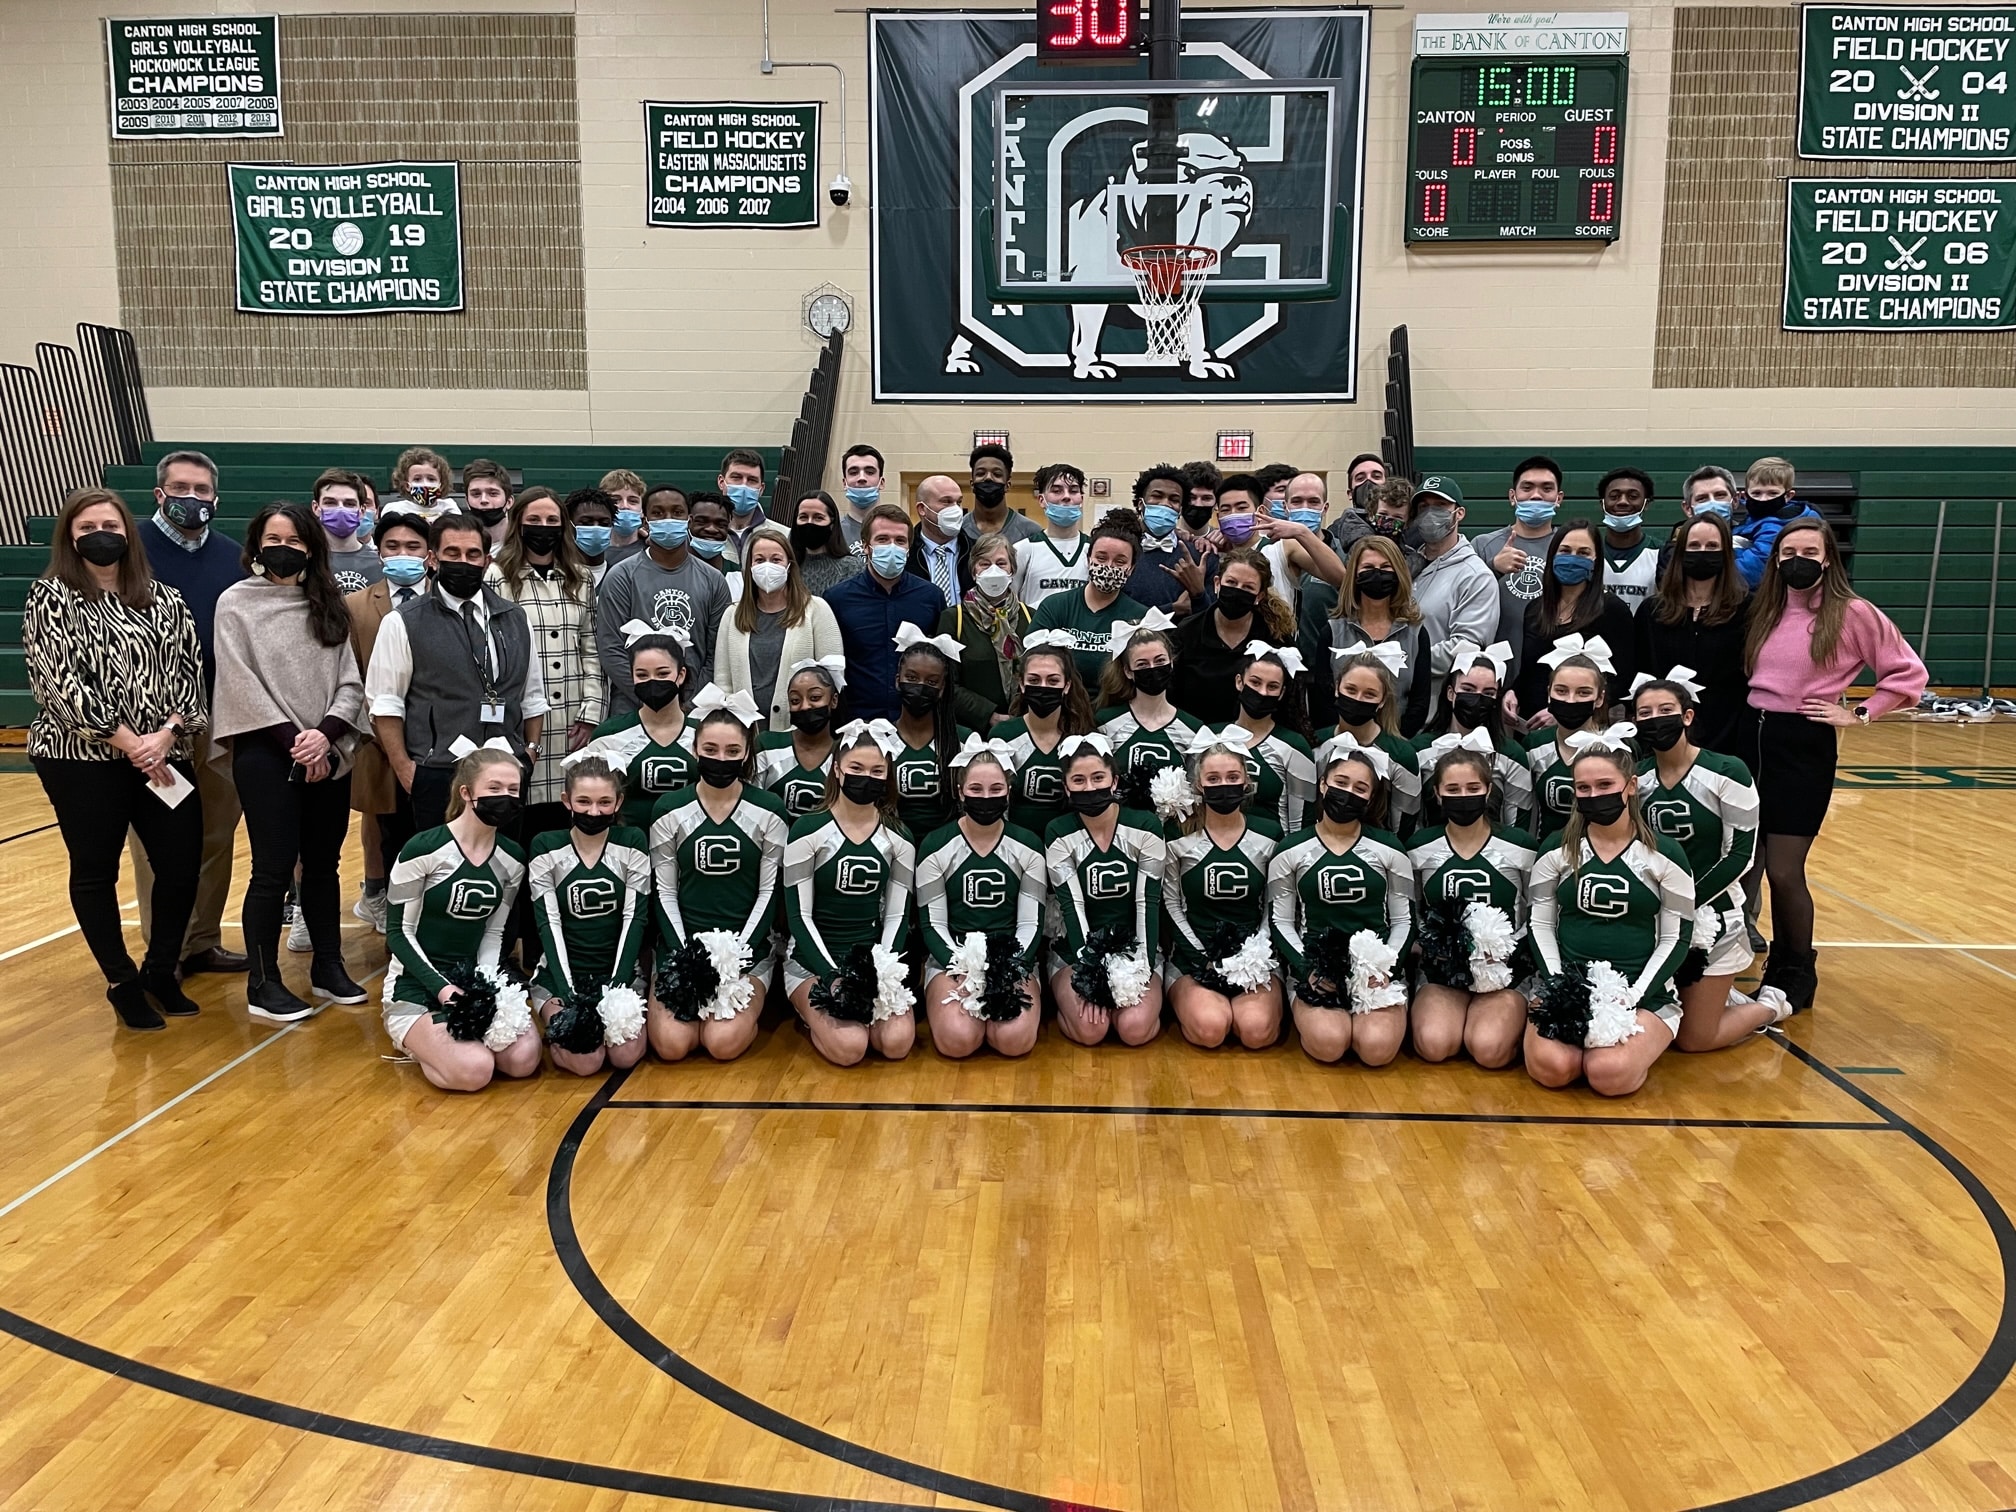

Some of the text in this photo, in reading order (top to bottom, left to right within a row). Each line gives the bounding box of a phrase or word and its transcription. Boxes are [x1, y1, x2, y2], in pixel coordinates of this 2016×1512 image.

[1488, 13, 1557, 28] We're with you!
[1832, 16, 2015, 32] CANTON HIGH SCHOOL
[124, 23, 261, 38] CANTON HIGH SCHOOL
[131, 39, 256, 56] GIRLS VOLLEYBALL
[1420, 32, 1622, 50] THE BANK OF CANTON
[1833, 37, 2010, 61] FIELD HOCKEY
[130, 58, 259, 74] HOCKOMOCK LEAGUE
[128, 76, 263, 94] CHAMPIONS
[1477, 67, 1575, 106] 15:00
[1829, 70, 2007, 94] 20 04
[121, 97, 274, 110] 2003 2004 2005 2007 2008
[1853, 103, 1980, 121] DIVISION II
[122, 113, 270, 128] 2009 2010 2011 2012 2013
[664, 114, 801, 127] CANTON HIGH SCHOOL
[1496, 112, 1536, 122] PERIOD
[1564, 109, 1614, 122] GUEST
[660, 131, 805, 149] FIELD HOCKEY
[1452, 126, 1616, 166] 0 0
[1500, 138, 1534, 149] POSS.
[1822, 126, 2011, 151] STATE CHAMPIONS
[659, 153, 806, 171] EASTERN MASSACHUSETTS
[1496, 153, 1535, 163] BONUS
[255, 172, 431, 191] CANTON HIGH SCHOOL
[1474, 169, 1516, 180] PLAYER
[1531, 168, 1560, 180] FOUL
[1579, 168, 1615, 178] FOULS
[665, 175, 801, 193] CHAMPIONS
[247, 193, 443, 219] GIRLS VOLLEYBALL
[654, 197, 771, 215] 2004 2006 2007
[1424, 182, 1613, 222] 0 0
[1814, 189, 2002, 204] CANTON HIGH SCHOOL
[1815, 209, 1998, 233] FIELD HOCKEY
[269, 224, 425, 250] 20 19
[1499, 226, 1536, 236] MATCH
[1821, 242, 1989, 265] 20 06
[288, 256, 409, 276] DIVISION II
[260, 279, 440, 303] STATE CHAMPIONS
[1837, 274, 1969, 292] DIVISION II
[1803, 297, 2001, 321] STATE CHAMPIONS
[1224, 438, 1246, 456] EXIT
[334, 570, 369, 584] ANTON
[1040, 578, 1088, 589] CANTO
[653, 588, 691, 601] CANTON
[1603, 584, 1648, 596] NTON
[1128, 742, 1170, 773] C
[641, 756, 688, 793] C
[897, 760, 941, 798] C
[1648, 800, 1695, 841] C
[694, 835, 740, 876] C
[835, 855, 881, 895] C
[841, 861, 849, 889] CANTON
[1086, 860, 1130, 900] C
[1204, 862, 1248, 900] C
[1317, 865, 1366, 904] C
[963, 869, 1006, 908] C
[1577, 873, 1630, 918] C
[1582, 880, 1592, 909] CANTON
[446, 878, 497, 919] C
[567, 878, 617, 919] C
